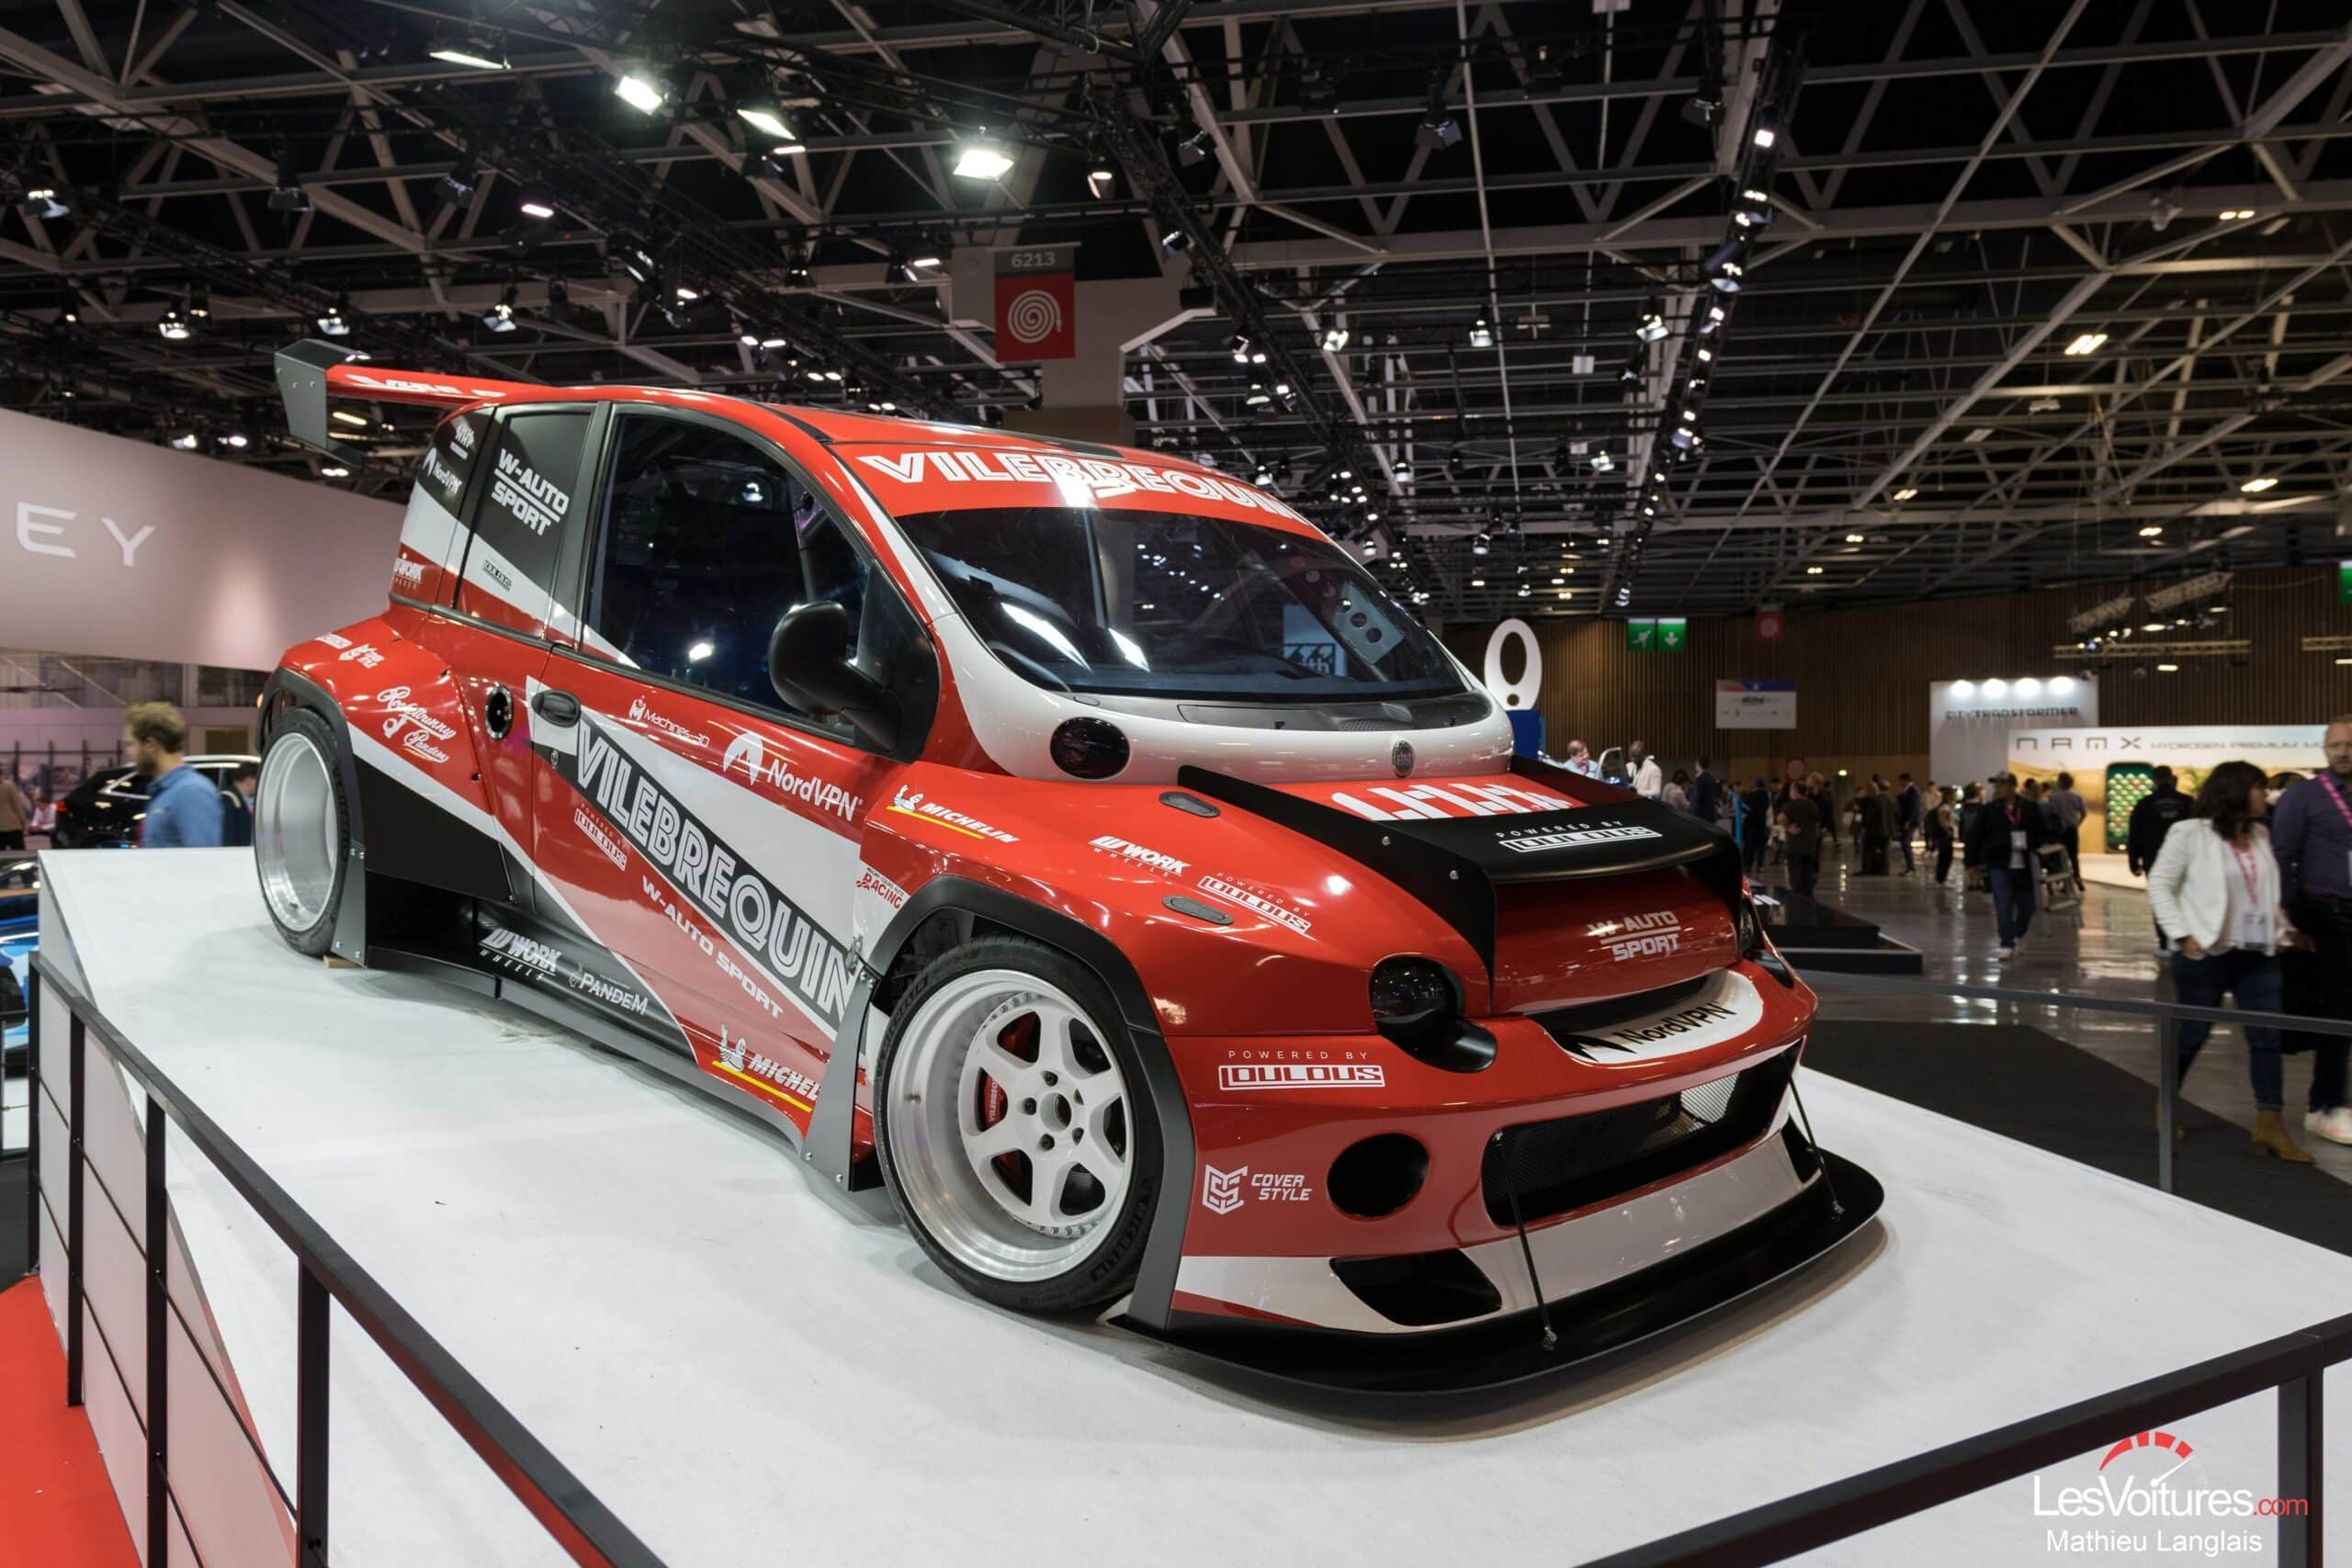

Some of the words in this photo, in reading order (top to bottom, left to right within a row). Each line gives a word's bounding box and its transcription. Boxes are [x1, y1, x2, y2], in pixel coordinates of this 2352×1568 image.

[1012, 252, 1056, 268] 6213
[497, 448, 570, 515] W-AUTO
[857, 451, 1308, 526] VILEBREQUIN
[492, 480, 551, 536] SPORT
[766, 759, 860, 822] NordVPN
[919, 803, 1021, 842] MICHELIN
[1496, 823, 1590, 838] POWERED
[577, 722, 865, 1024] VILEBREQUIN
[1123, 842, 1191, 874] WORK
[856, 873, 902, 909] RACING
[1216, 872, 1283, 904] POWERED
[1587, 910, 1679, 937] W-AUTO
[507, 933, 562, 972] WORK
[643, 875, 715, 955] W-AUTO
[717, 952, 783, 1019] SPORT
[1611, 933, 1679, 962] SPORT
[1612, 1001, 1737, 1045] NordVPN
[1228, 1050, 1329, 1059] POWERED
[1346, 1051, 1367, 1059] BY
[748, 1053, 821, 1101] MICHEL
[1251, 1173, 1305, 1188] COVER
[1258, 1188, 1313, 1201] STYLE
